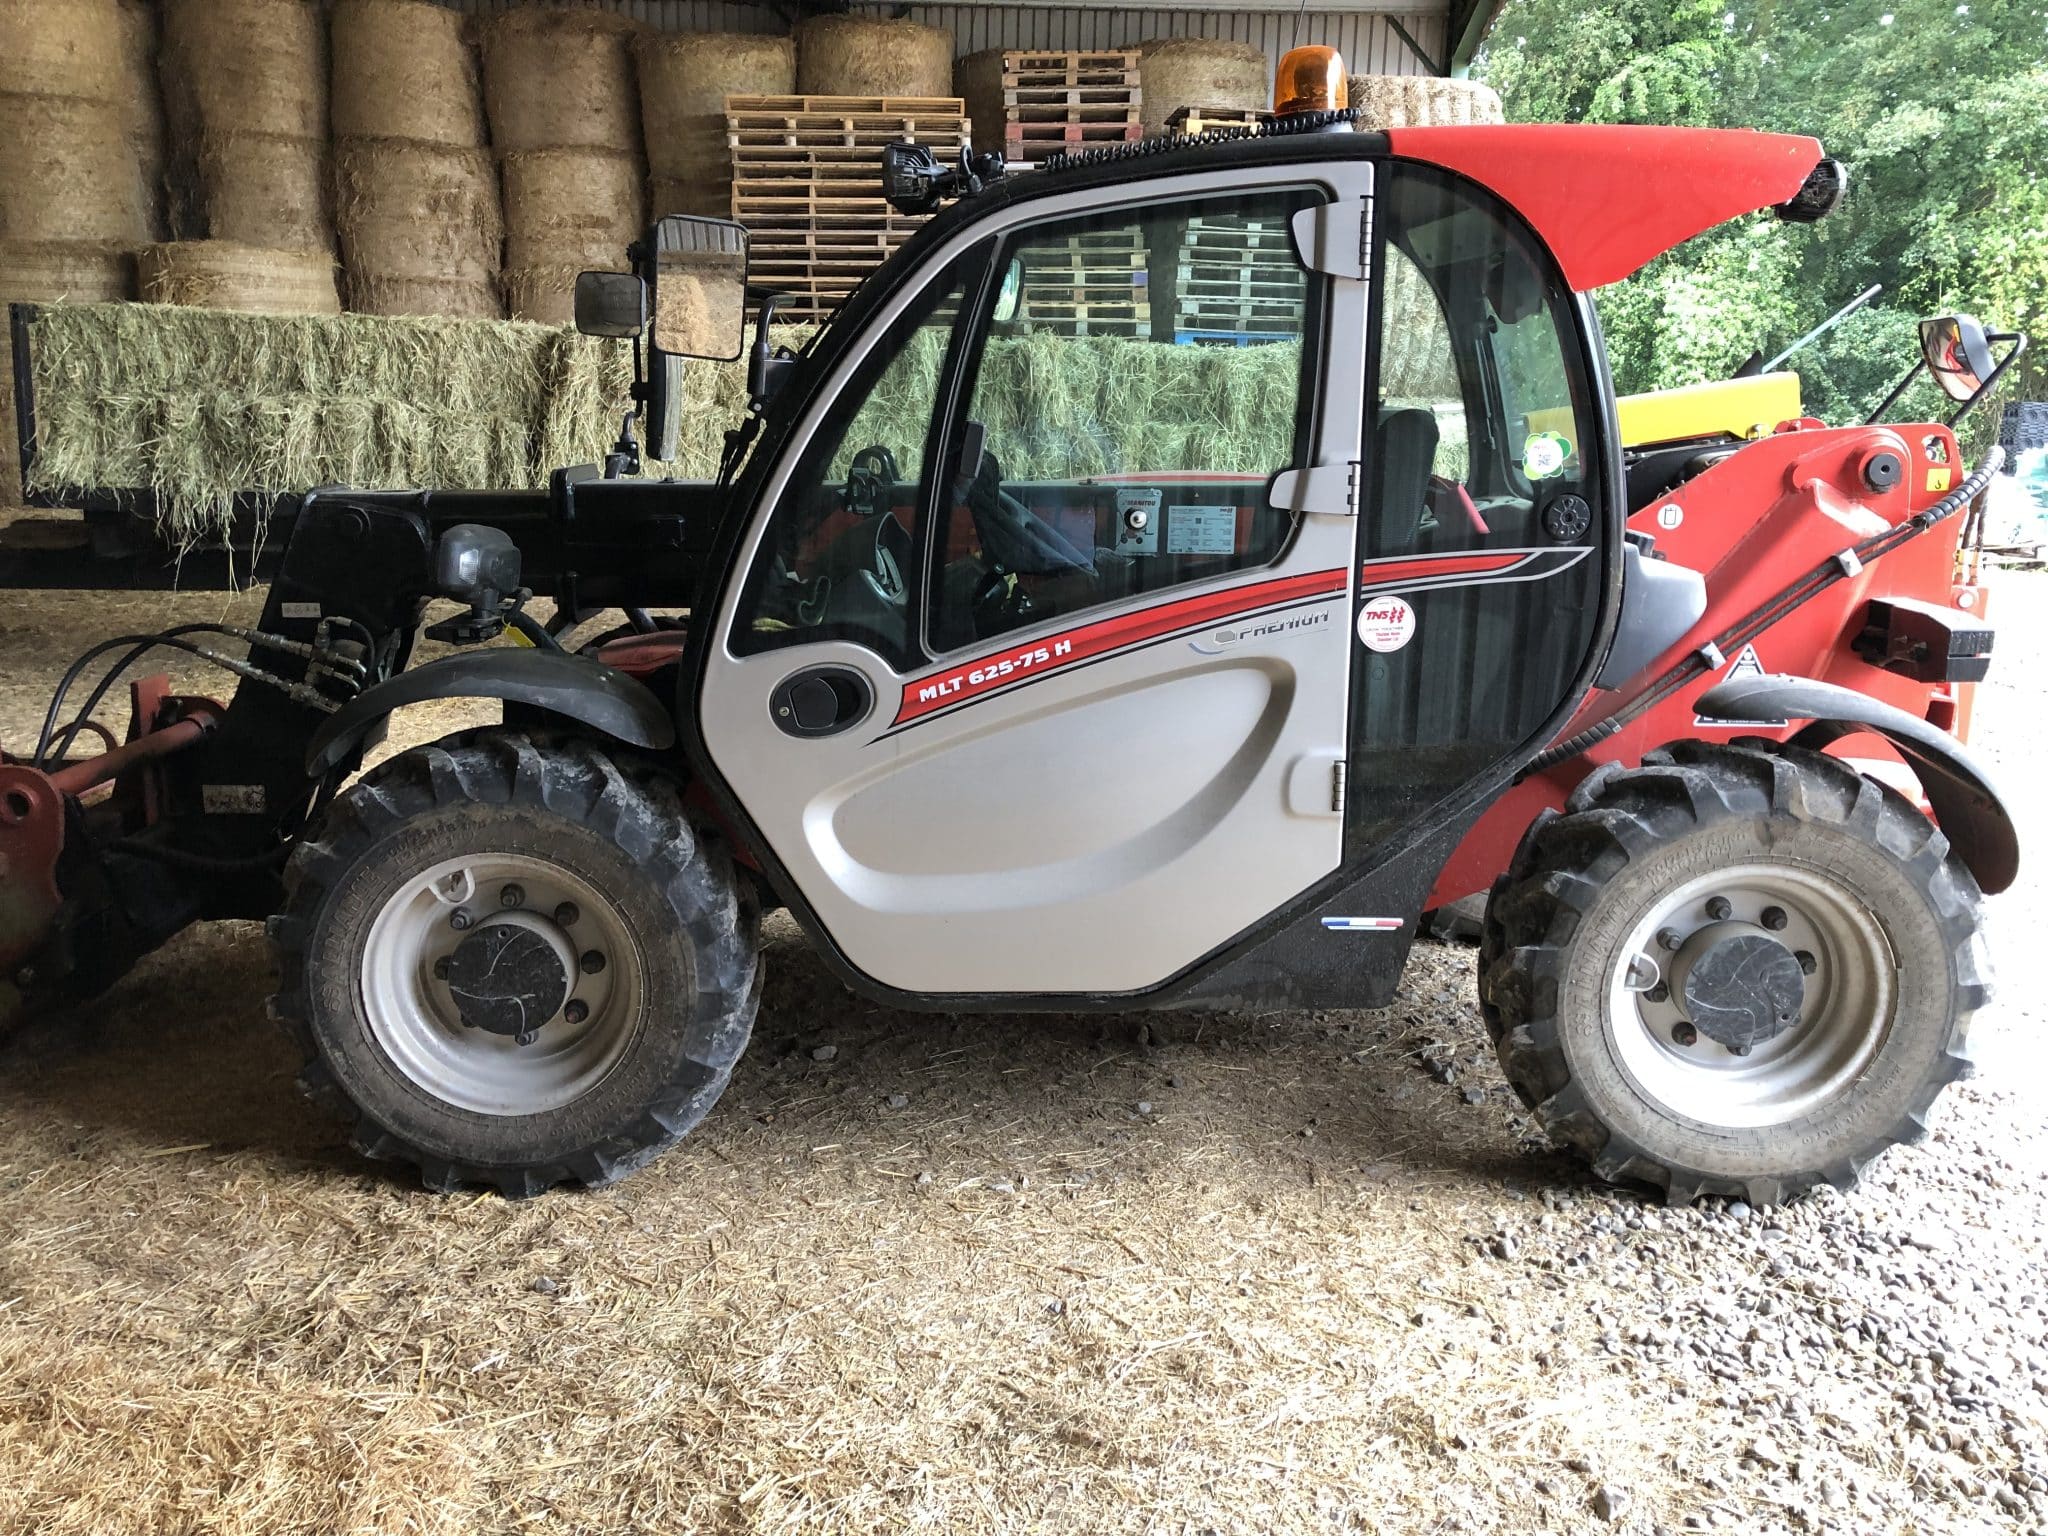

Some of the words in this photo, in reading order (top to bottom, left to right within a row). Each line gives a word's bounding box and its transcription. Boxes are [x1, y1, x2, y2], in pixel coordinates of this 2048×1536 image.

[1366, 610, 1389, 621] TNS
[919, 676, 963, 702] MLT
[968, 647, 1049, 685] 625-75
[1054, 639, 1072, 656] H
